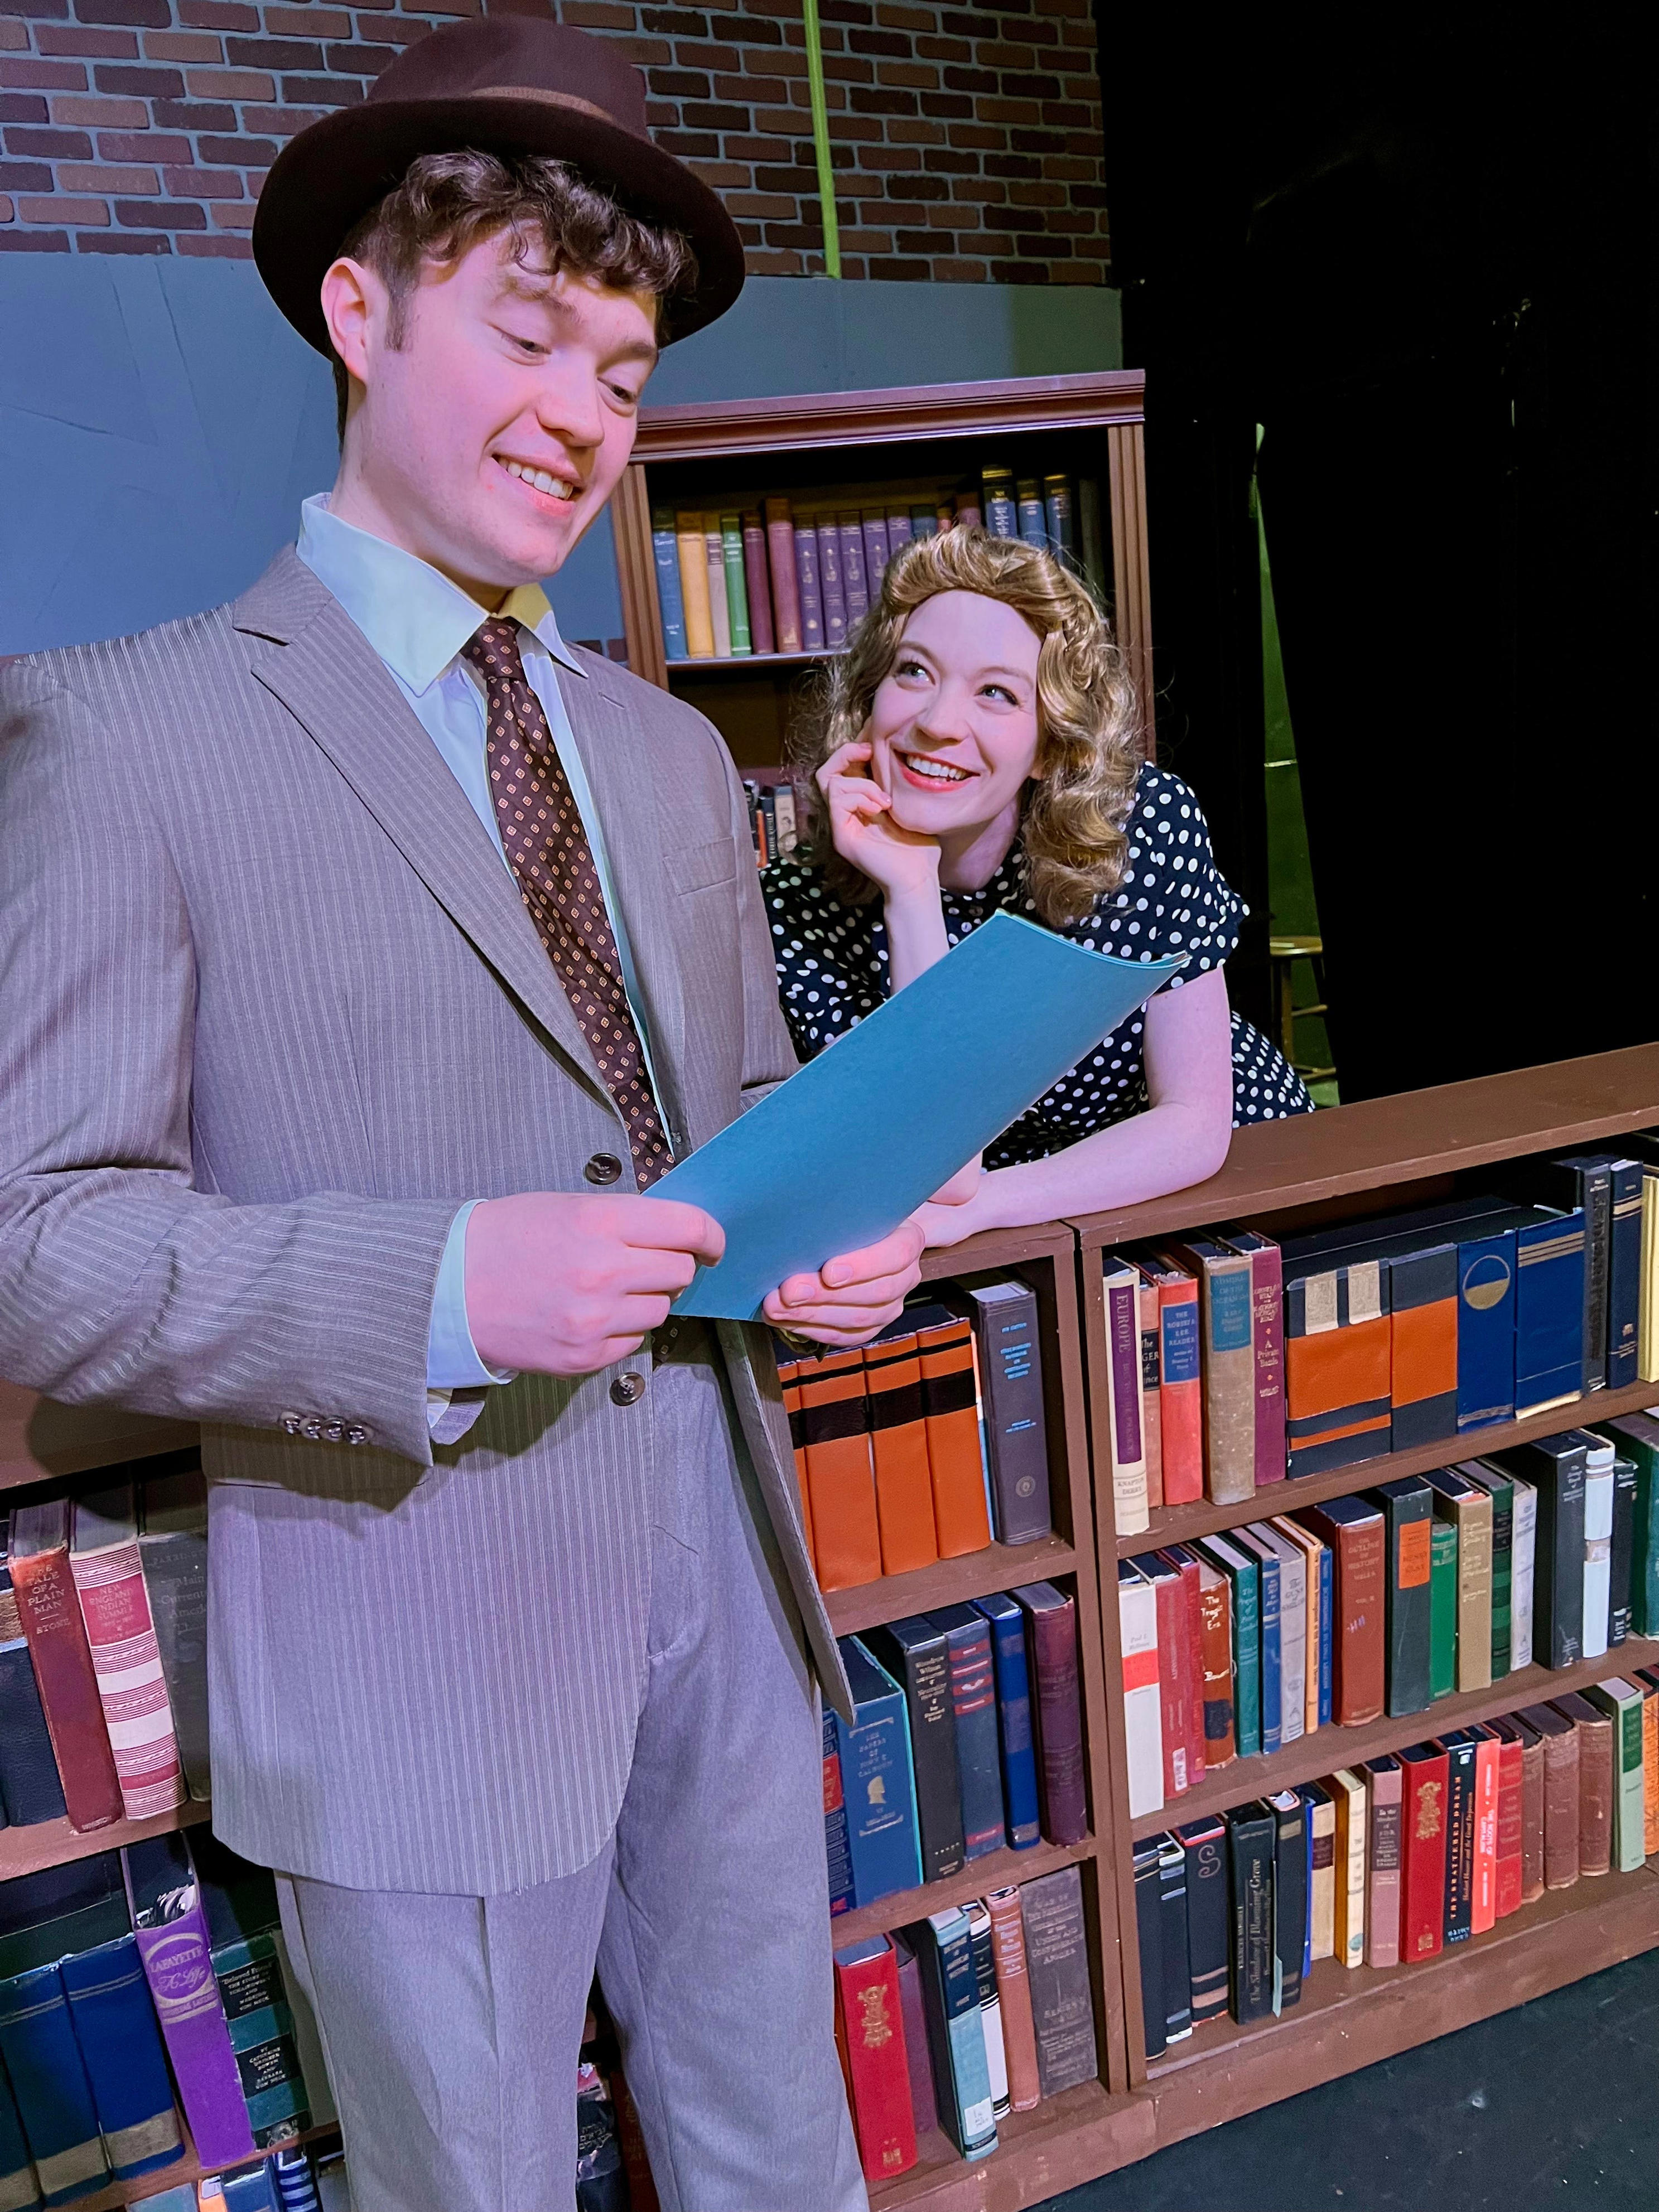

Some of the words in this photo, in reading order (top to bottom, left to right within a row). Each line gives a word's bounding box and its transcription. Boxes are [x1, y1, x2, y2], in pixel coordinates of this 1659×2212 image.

[1116, 1294, 1131, 1353] EUROPE
[27, 1588, 65, 1606] PLAIN
[33, 1599, 62, 1614] MAN
[36, 1618, 71, 1635] STONE
[1453, 1776, 1462, 1817] DREAM
[1451, 1822, 1459, 1892] SHATTERED
[1249, 1859, 1261, 1889] Grove
[1249, 1891, 1265, 1935] Blooming
[151, 1945, 204, 1973] LAFAYETTE
[1250, 1947, 1261, 1984] Shadow
[1250, 1986, 1261, 2003] The
